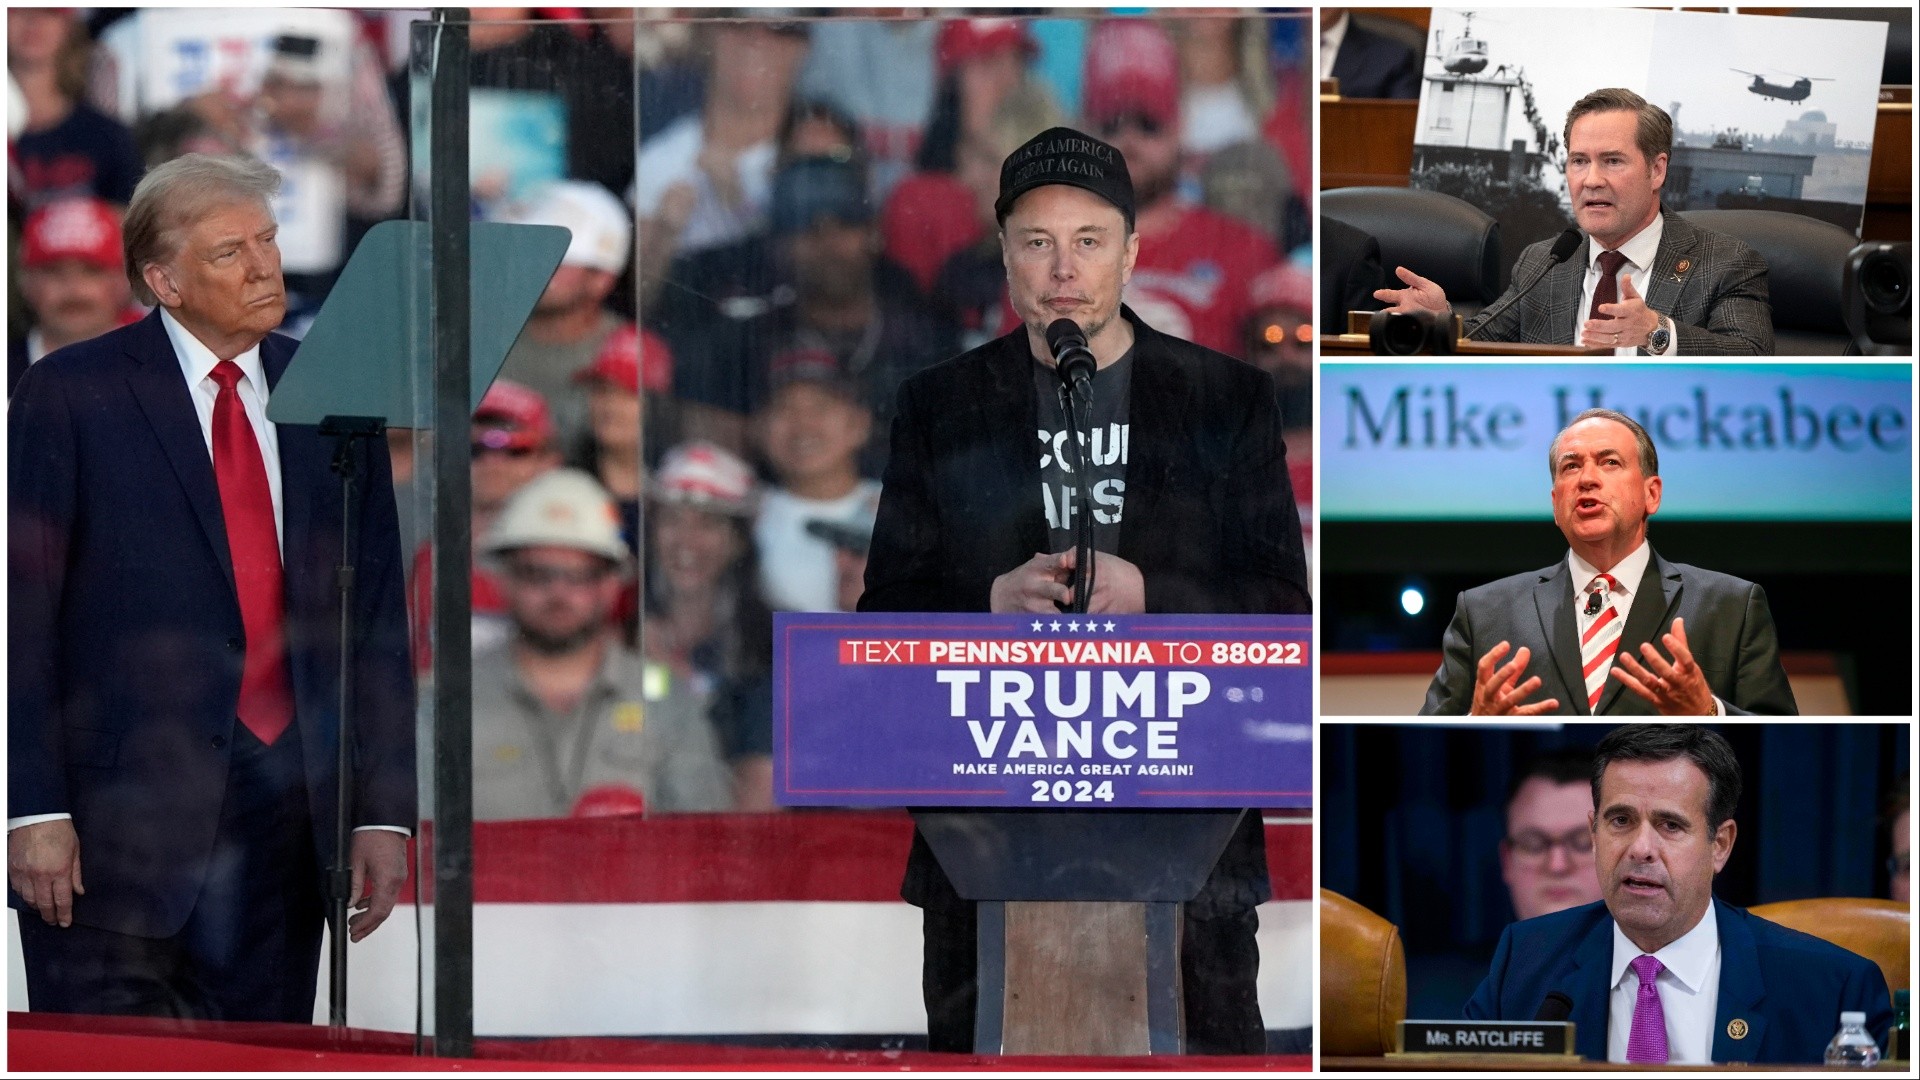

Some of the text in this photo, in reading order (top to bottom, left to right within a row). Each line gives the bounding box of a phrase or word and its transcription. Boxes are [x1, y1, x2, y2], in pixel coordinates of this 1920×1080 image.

[1045, 138, 1114, 165] AMERICA
[1056, 157, 1105, 180] AGAIN
[1343, 384, 1908, 450] Mike Hckabee
[847, 641, 1301, 665] TEXT PENNSYLVANIA TO 88022
[936, 670, 1212, 718] TRUMP
[966, 721, 1179, 759] VANCE
[952, 763, 1194, 776] MAKE AMERICA GREAT AGAIN!
[1031, 780, 1115, 802] 2024
[1456, 1030, 1544, 1047] RATCLIFFE
